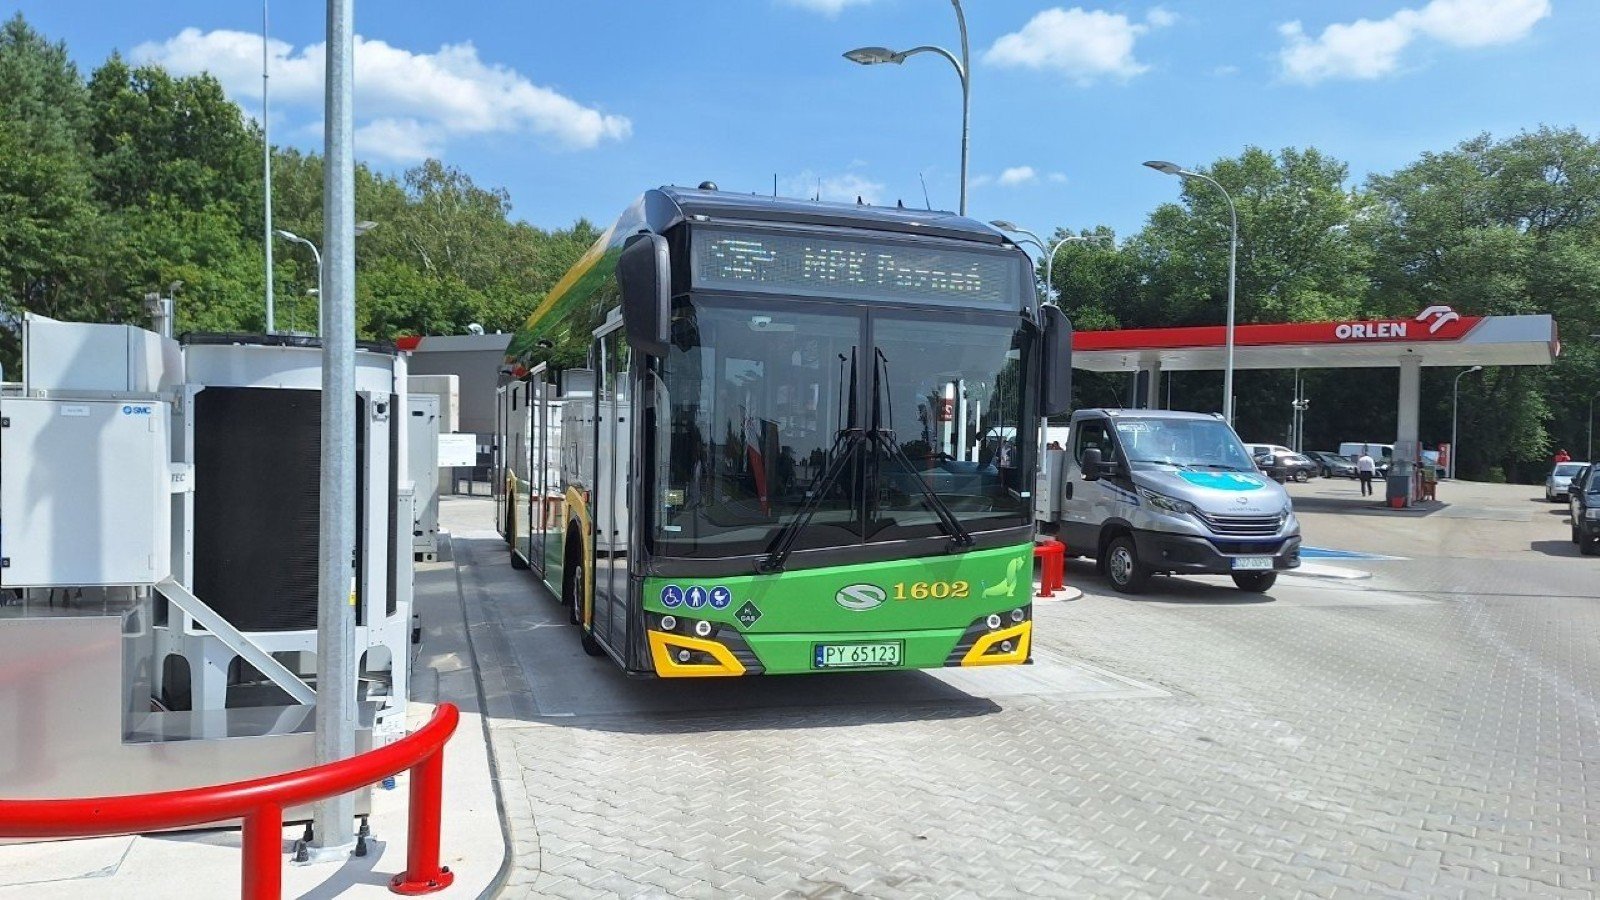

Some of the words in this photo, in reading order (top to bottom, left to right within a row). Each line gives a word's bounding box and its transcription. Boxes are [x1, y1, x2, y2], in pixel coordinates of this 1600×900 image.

[804, 247, 867, 283] MPK
[1335, 322, 1407, 339] ORLEN
[133, 406, 151, 415] SMC
[893, 580, 970, 600] 1602
[826, 647, 847, 663] PY
[851, 646, 896, 662] 65123
